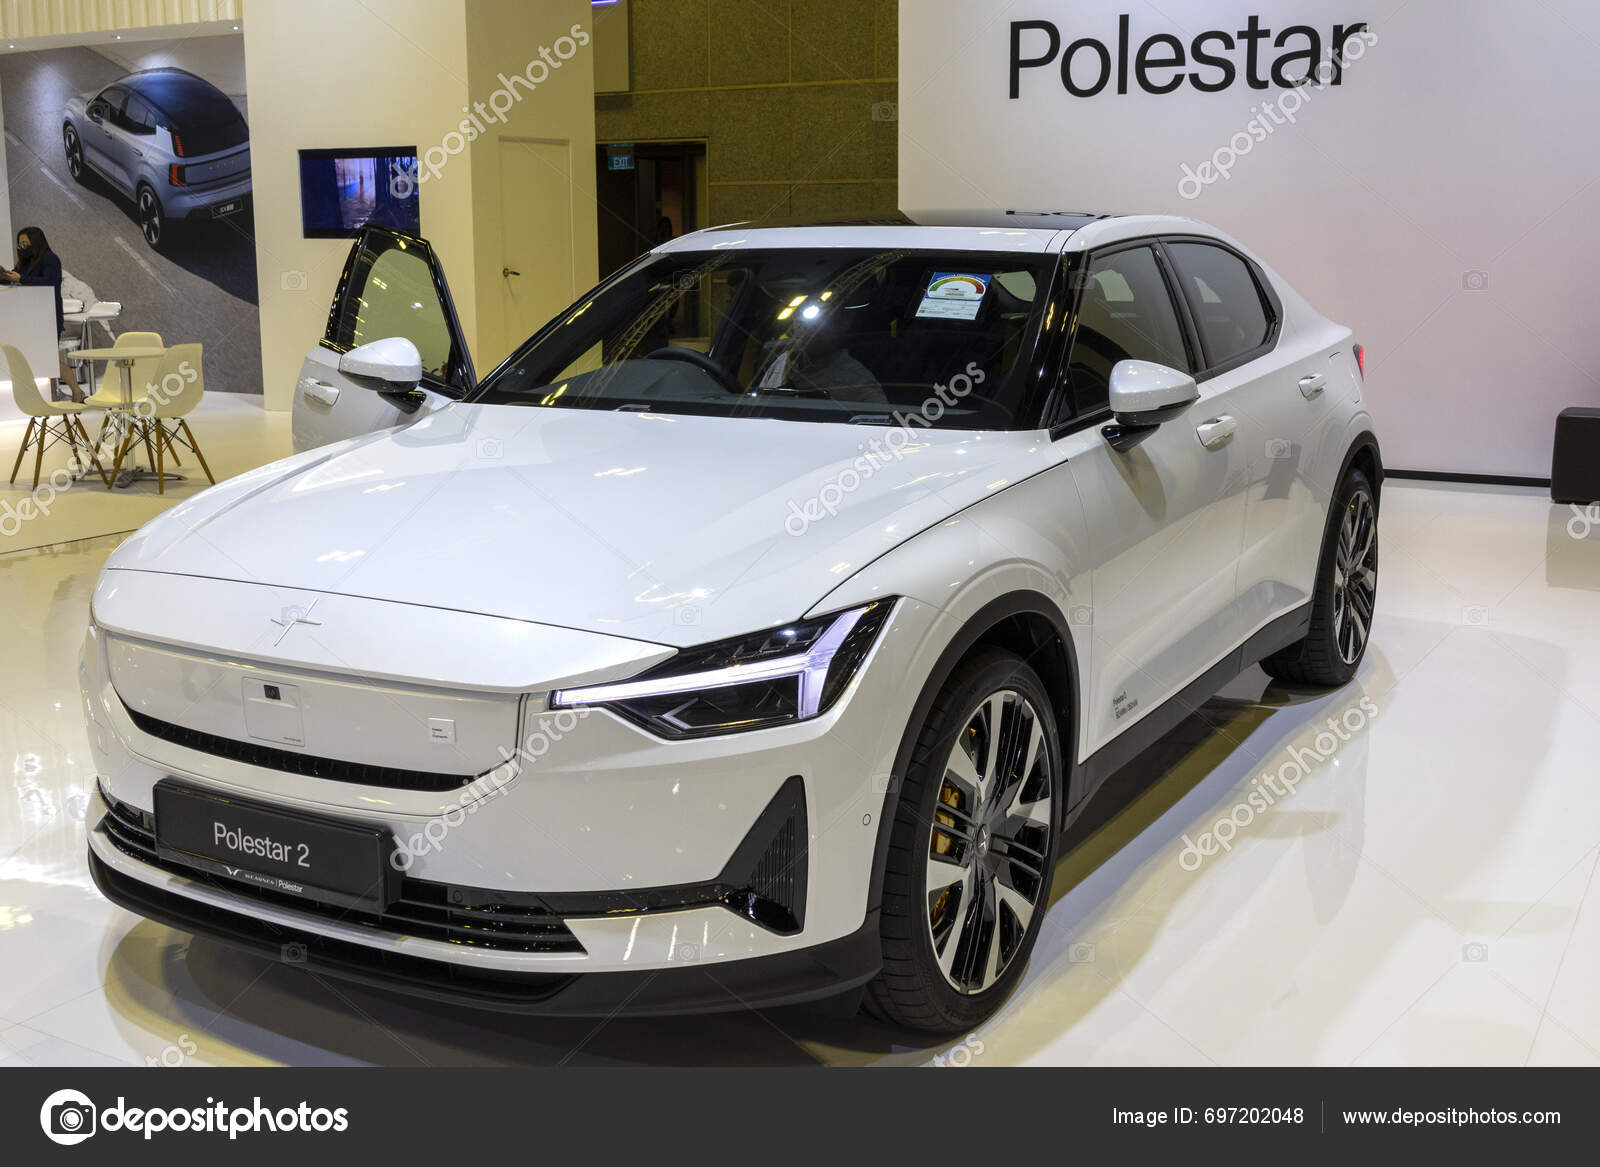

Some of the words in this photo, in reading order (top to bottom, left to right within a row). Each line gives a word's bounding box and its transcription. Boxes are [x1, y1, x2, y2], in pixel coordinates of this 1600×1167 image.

[1009, 15, 1368, 99] Polestar
[214, 821, 293, 863] Polestar
[297, 843, 311, 868] 2
[278, 879, 304, 894] Polestar
